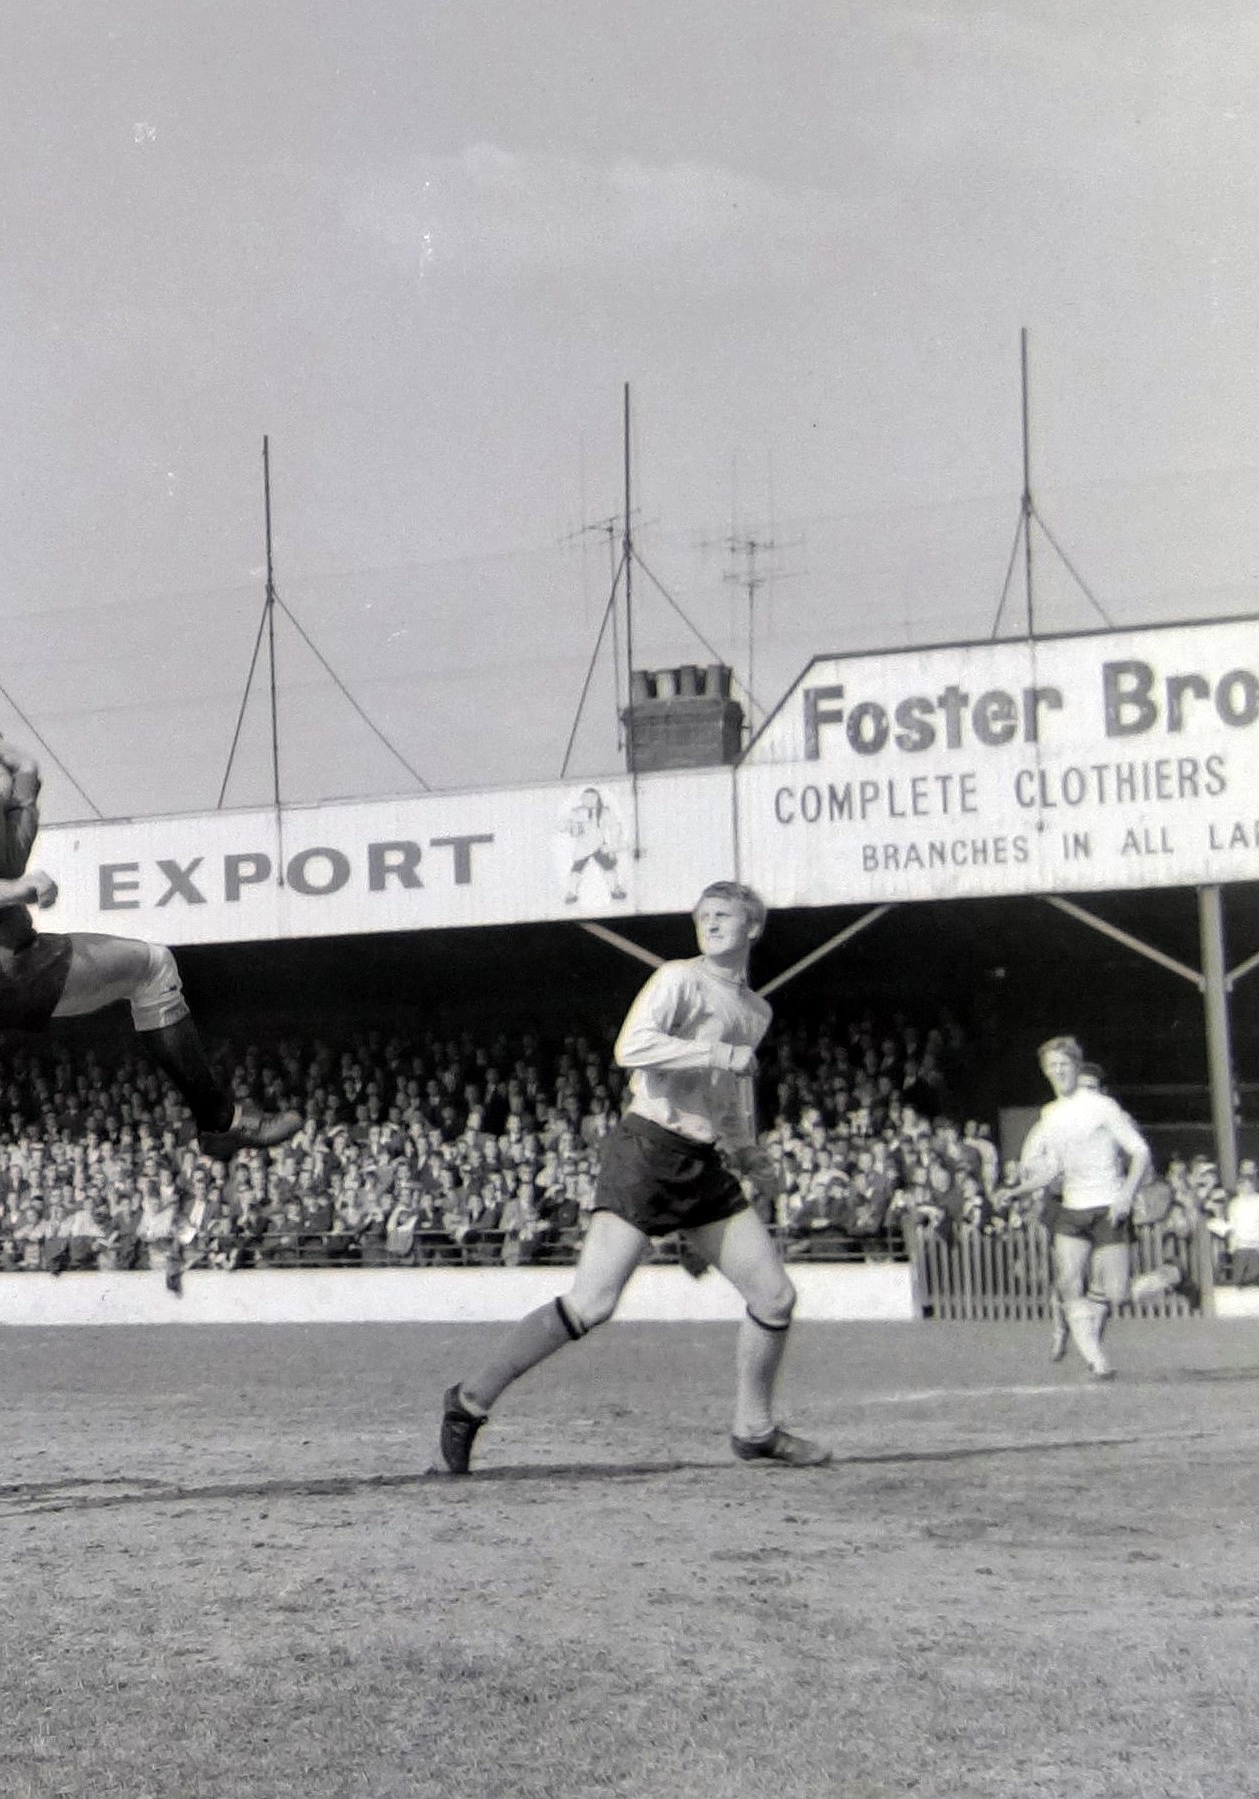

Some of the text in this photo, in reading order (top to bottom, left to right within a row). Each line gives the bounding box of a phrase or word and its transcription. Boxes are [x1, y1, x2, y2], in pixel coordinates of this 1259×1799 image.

[803, 659, 1259, 761] Foster Bro
[775, 756, 1228, 825] COMPLETE CLOTHIERS
[98, 833, 494, 911] EXPORT
[861, 819, 1259, 872] BRANCHES IN ALL LA
